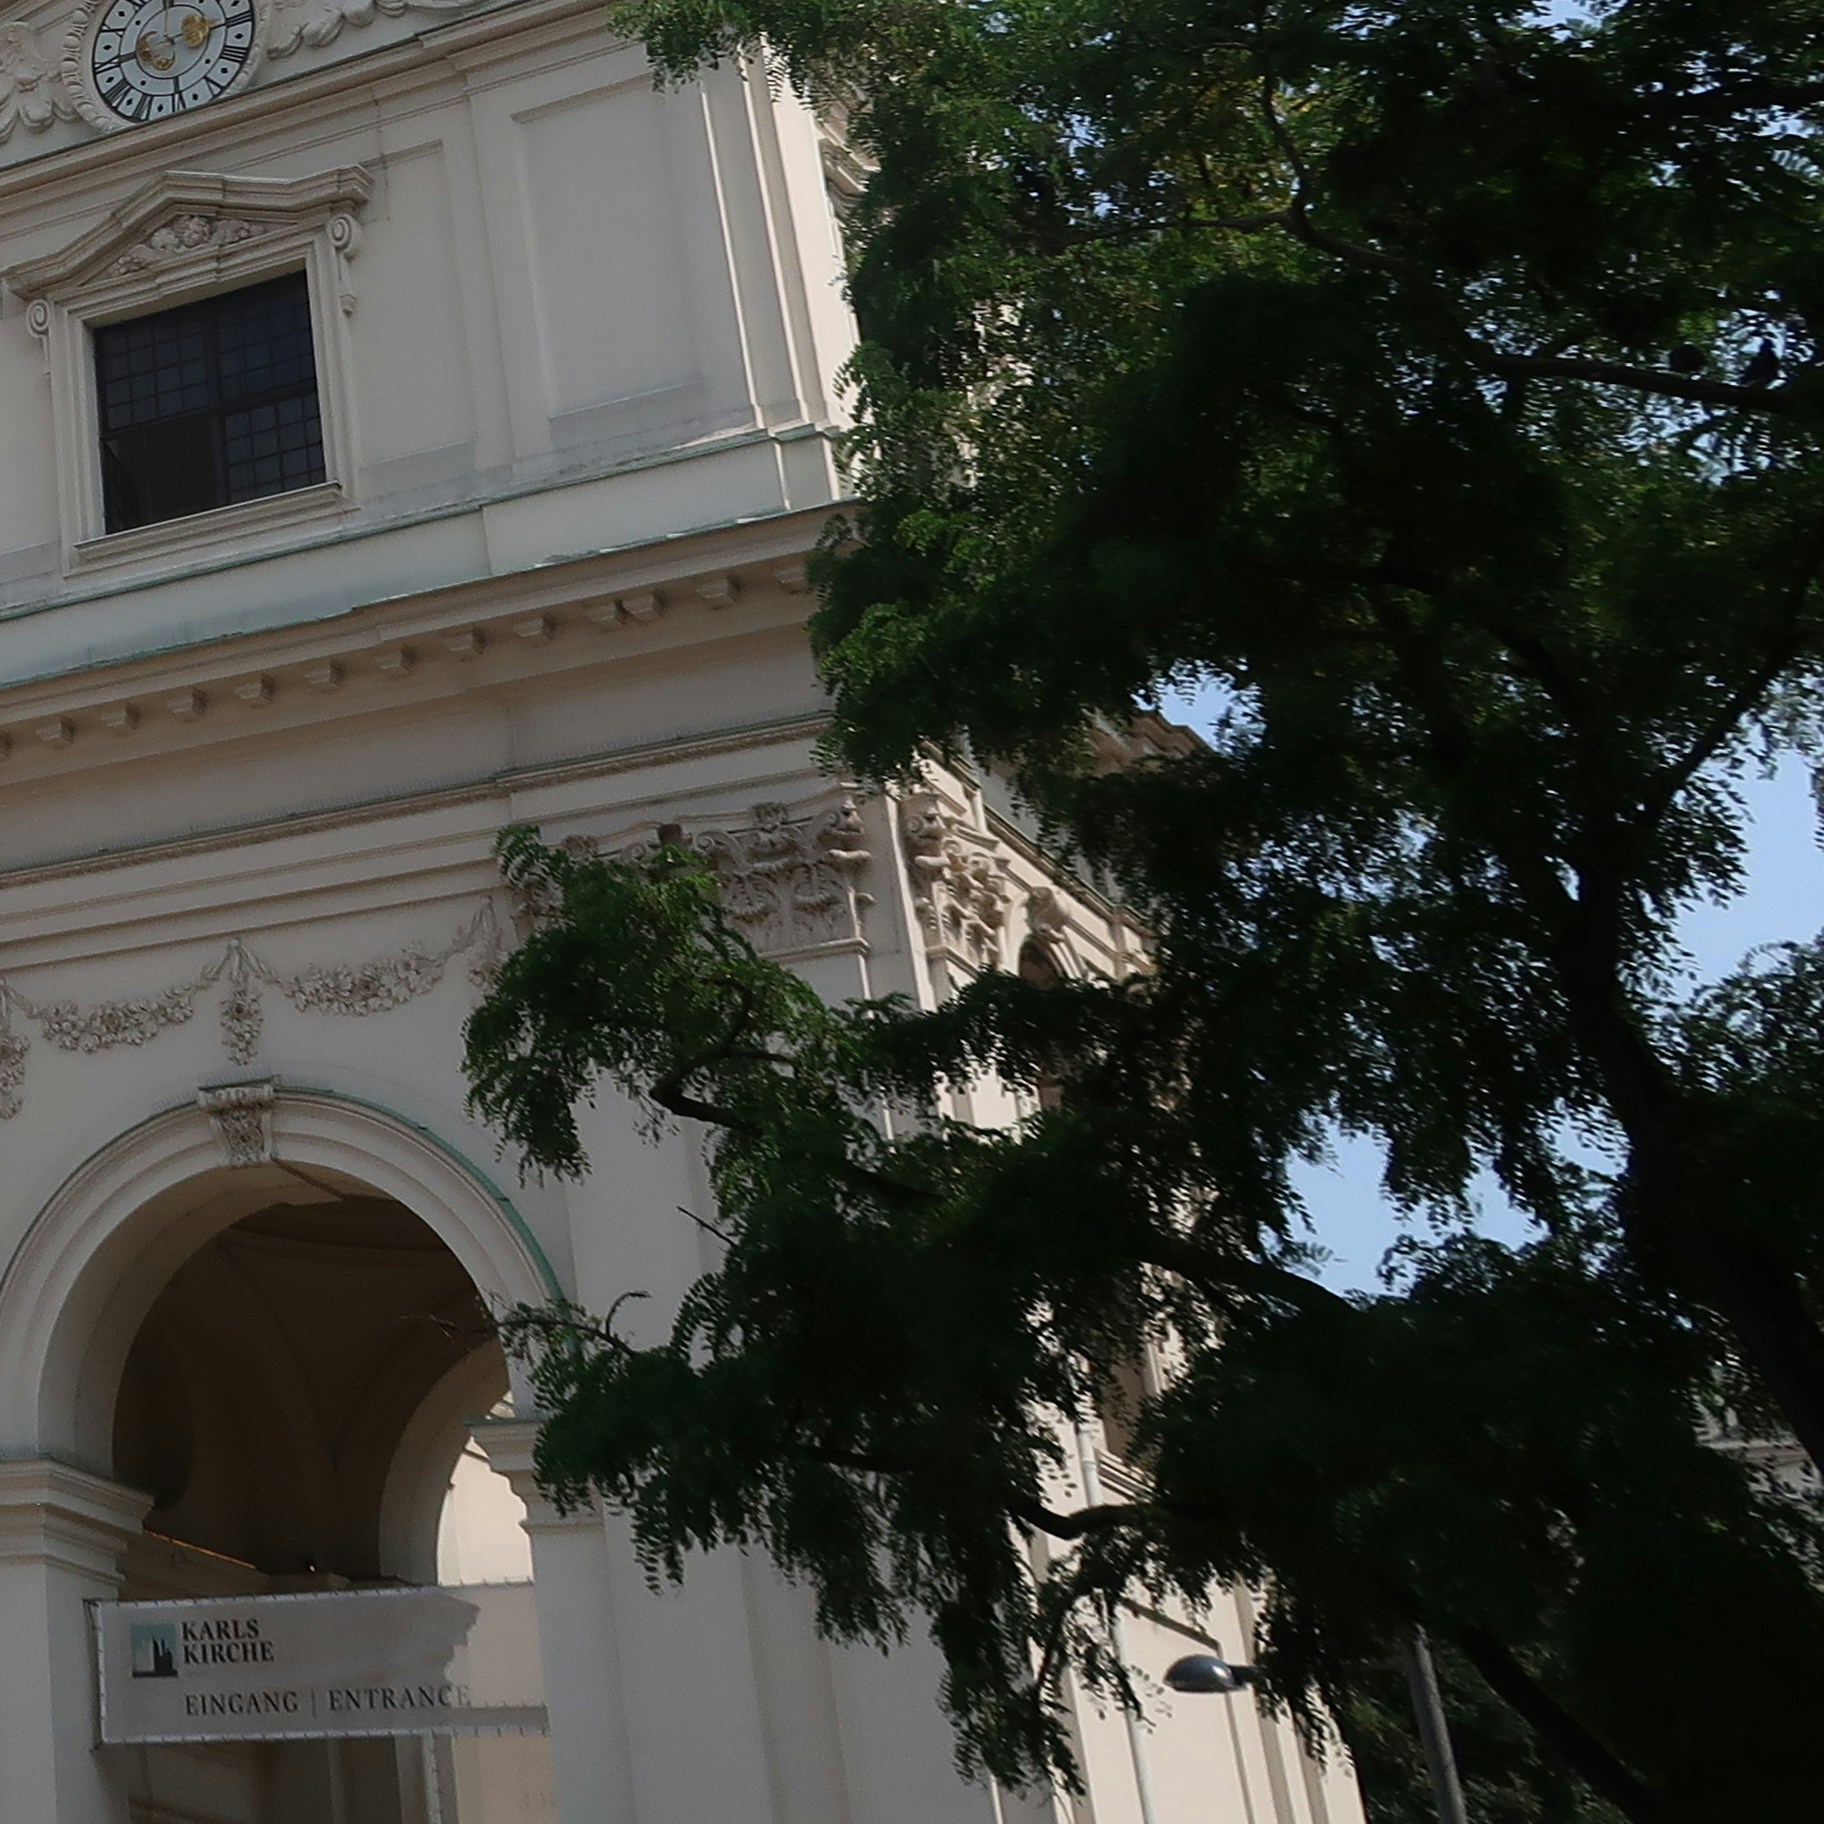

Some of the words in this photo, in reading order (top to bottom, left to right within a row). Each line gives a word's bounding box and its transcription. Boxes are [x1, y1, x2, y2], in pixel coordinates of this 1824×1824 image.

[181, 1618, 260, 1642] KARLS
[182, 1641, 274, 1664] KIRCHE
[185, 1691, 298, 1716] EINGANG
[328, 1684, 473, 1712] ENTRANCE
